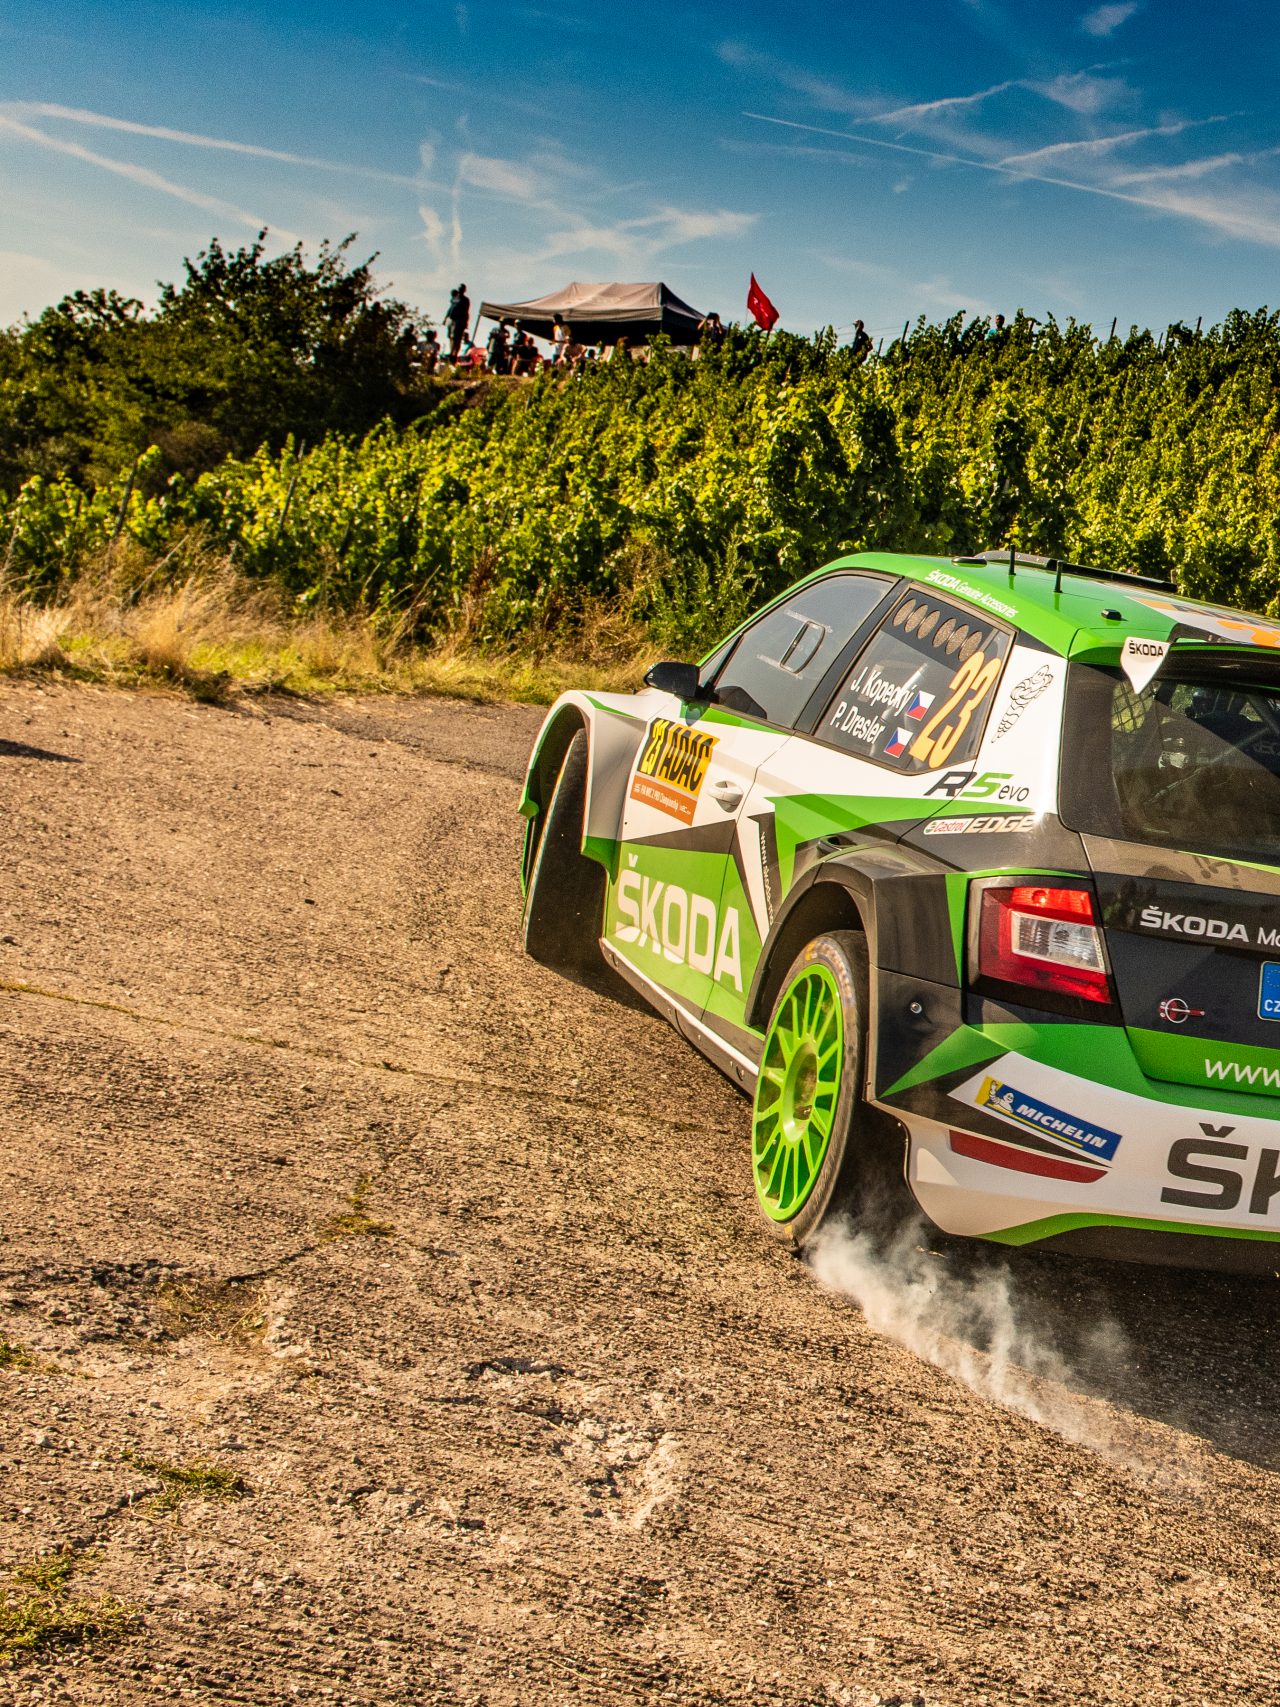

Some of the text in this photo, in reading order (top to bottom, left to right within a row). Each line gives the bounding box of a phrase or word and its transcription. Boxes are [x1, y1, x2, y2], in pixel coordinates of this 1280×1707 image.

[924, 569, 961, 589] ŠKODA
[1129, 640, 1164, 657] ŠKODA
[850, 666, 916, 716] J. Kopecký
[908, 651, 1001, 768] 23
[829, 701, 886, 745] P. Dresler
[640, 720, 714, 791] 23 ADAC
[923, 771, 1030, 802] R5 evo
[933, 816, 1035, 834] Castrol EDGE
[616, 852, 743, 993] ŠKODA
[1140, 905, 1250, 943] ŠKODA
[1016, 1104, 1107, 1148] MICHELIN
